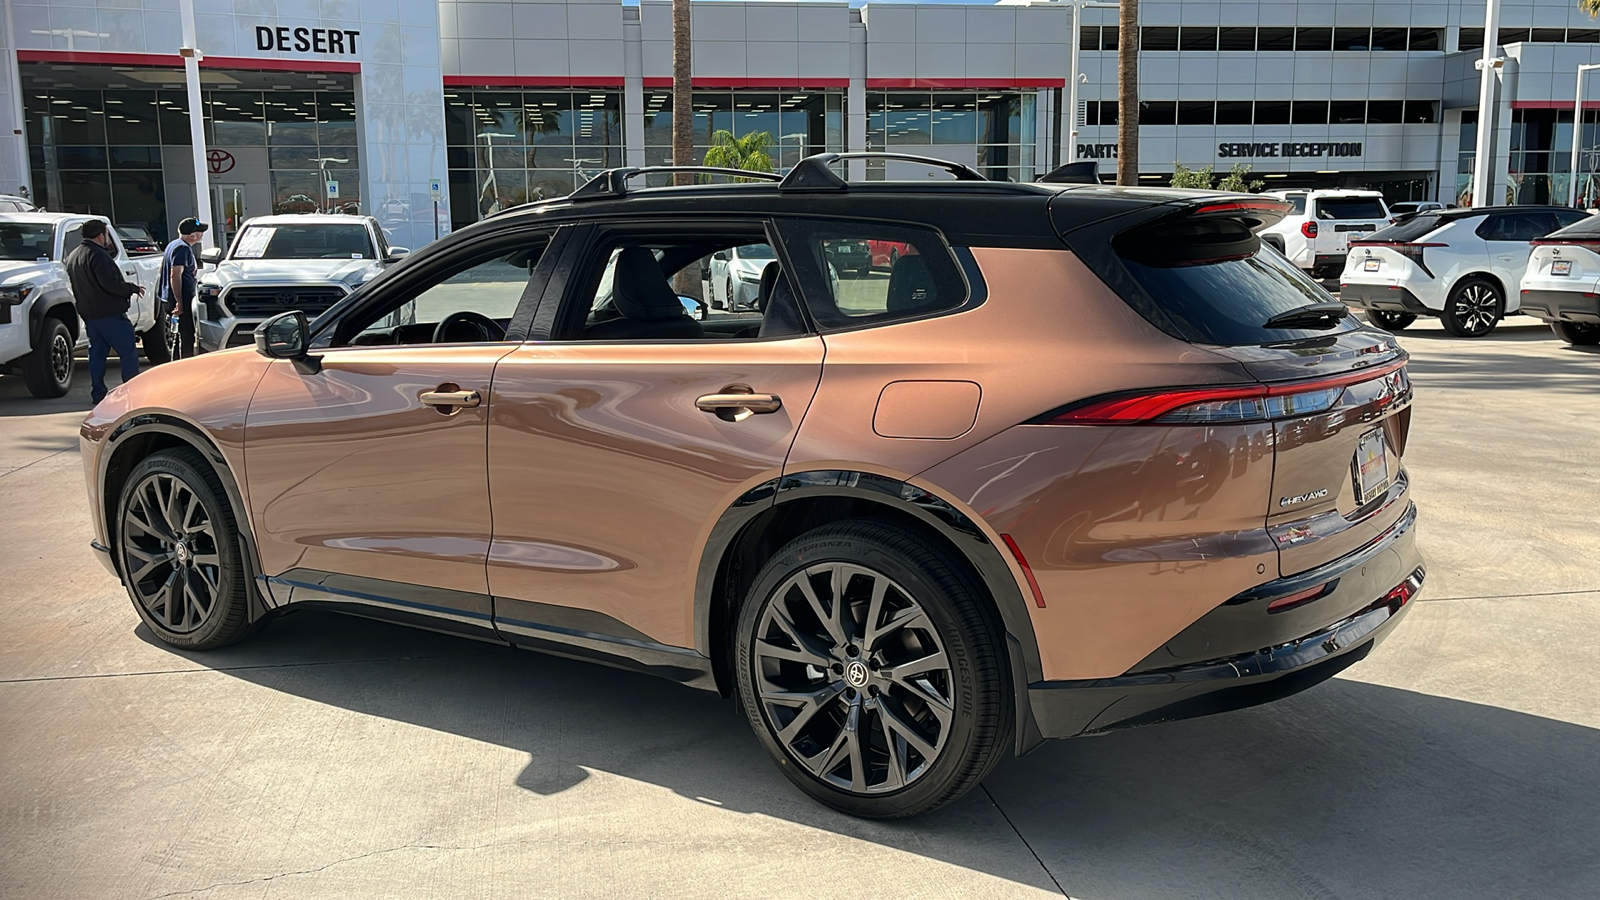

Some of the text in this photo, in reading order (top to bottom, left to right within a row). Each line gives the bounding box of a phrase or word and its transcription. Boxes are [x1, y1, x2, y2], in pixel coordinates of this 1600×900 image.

[255, 26, 360, 54] DESERT
[1218, 142, 1362, 158] SERVICE RECEPTION
